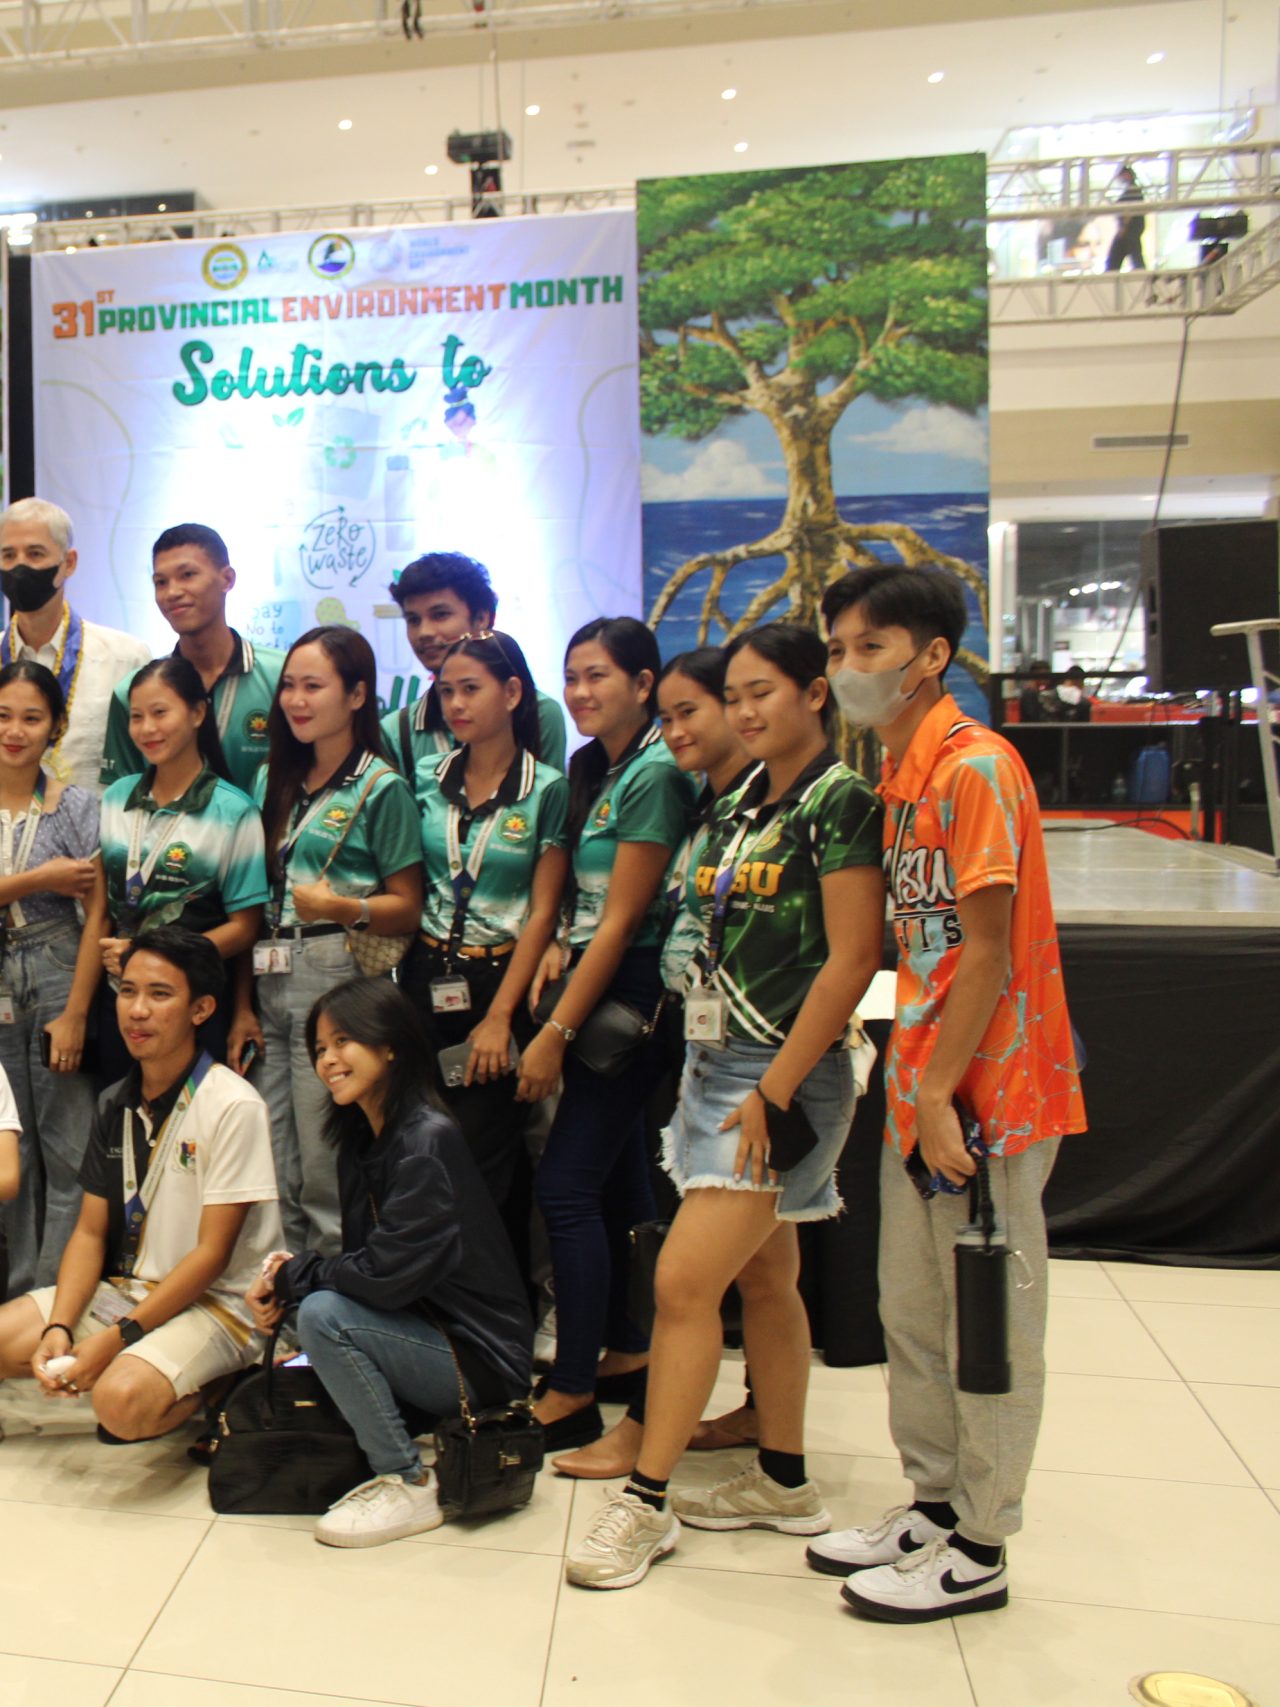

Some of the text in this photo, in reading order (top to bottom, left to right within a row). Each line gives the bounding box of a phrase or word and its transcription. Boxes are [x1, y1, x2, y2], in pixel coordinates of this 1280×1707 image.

[98, 298, 277, 335] PROVINCIAL
[282, 284, 507, 322] ENVIRONMENT
[510, 275, 624, 310] MONTH
[173, 334, 492, 406] Solutions to
